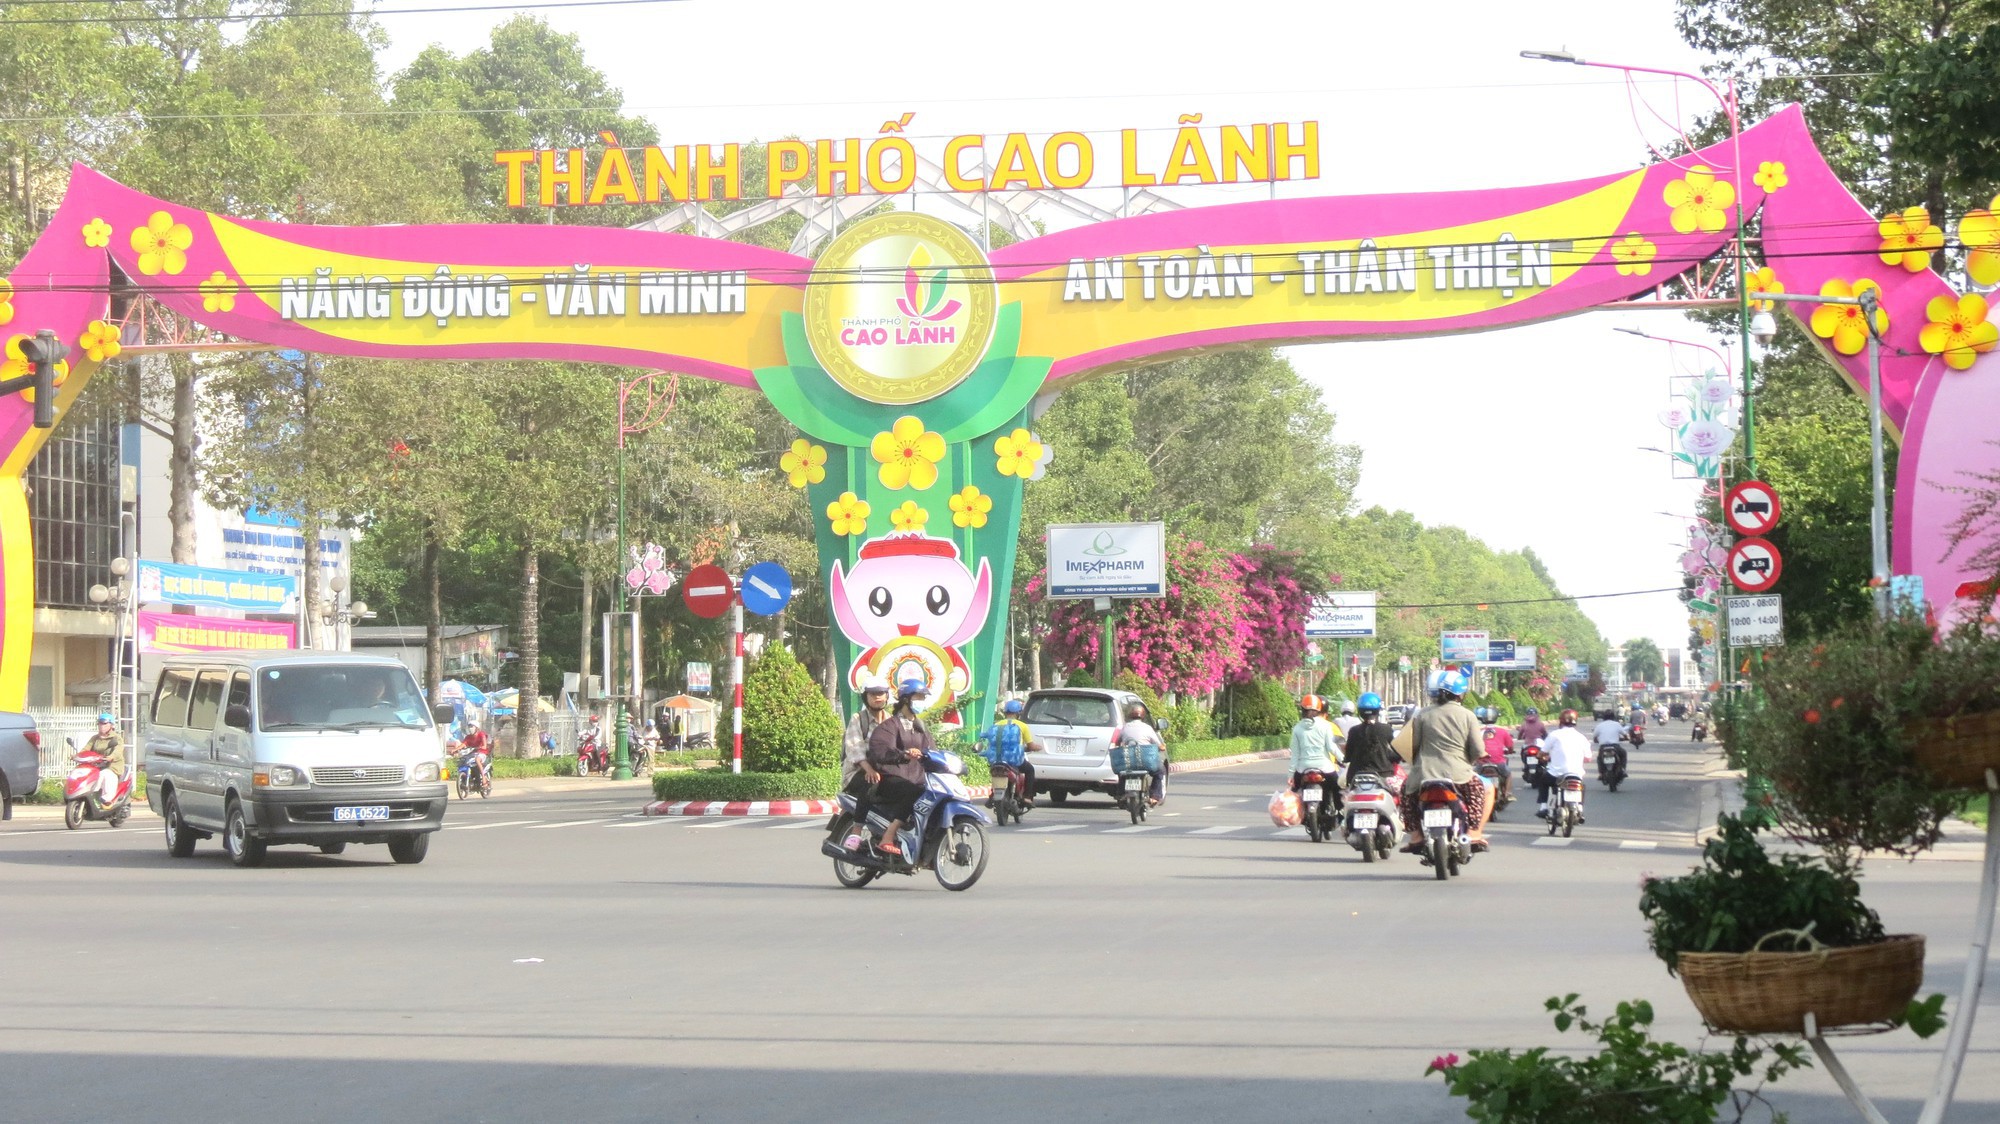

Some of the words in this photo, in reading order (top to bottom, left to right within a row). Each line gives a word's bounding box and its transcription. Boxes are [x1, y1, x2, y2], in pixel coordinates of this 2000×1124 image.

[495, 131, 741, 208] THÀNH
[768, 112, 916, 198] PHỐ
[944, 132, 1094, 192] CAO
[1122, 112, 1320, 186] LÃNH
[1062, 256, 1124, 302] AN
[1136, 244, 1254, 299] TOÀN
[1298, 238, 1416, 295] THÂN
[1427, 232, 1552, 299] THIỆN
[280, 266, 391, 320] NĂNG
[402, 265, 510, 327] ĐỘNG
[543, 263, 626, 317] VĂN
[638, 271, 747, 315] MINH
[842, 316, 877, 326] THÀNH
[880, 316, 902, 326] PHỐ
[841, 328, 888, 346] CAO
[896, 320, 955, 345] LÃNH
[1066, 559, 1144, 574] IMEXPHARM
[1730, 600, 1750, 608] 05:00
[1757, 598, 1777, 607] 08:00
[1731, 617, 1751, 626] 10:00
[1758, 616, 1778, 624] 14:00
[338, 808, 386, 819] 66A-0522
